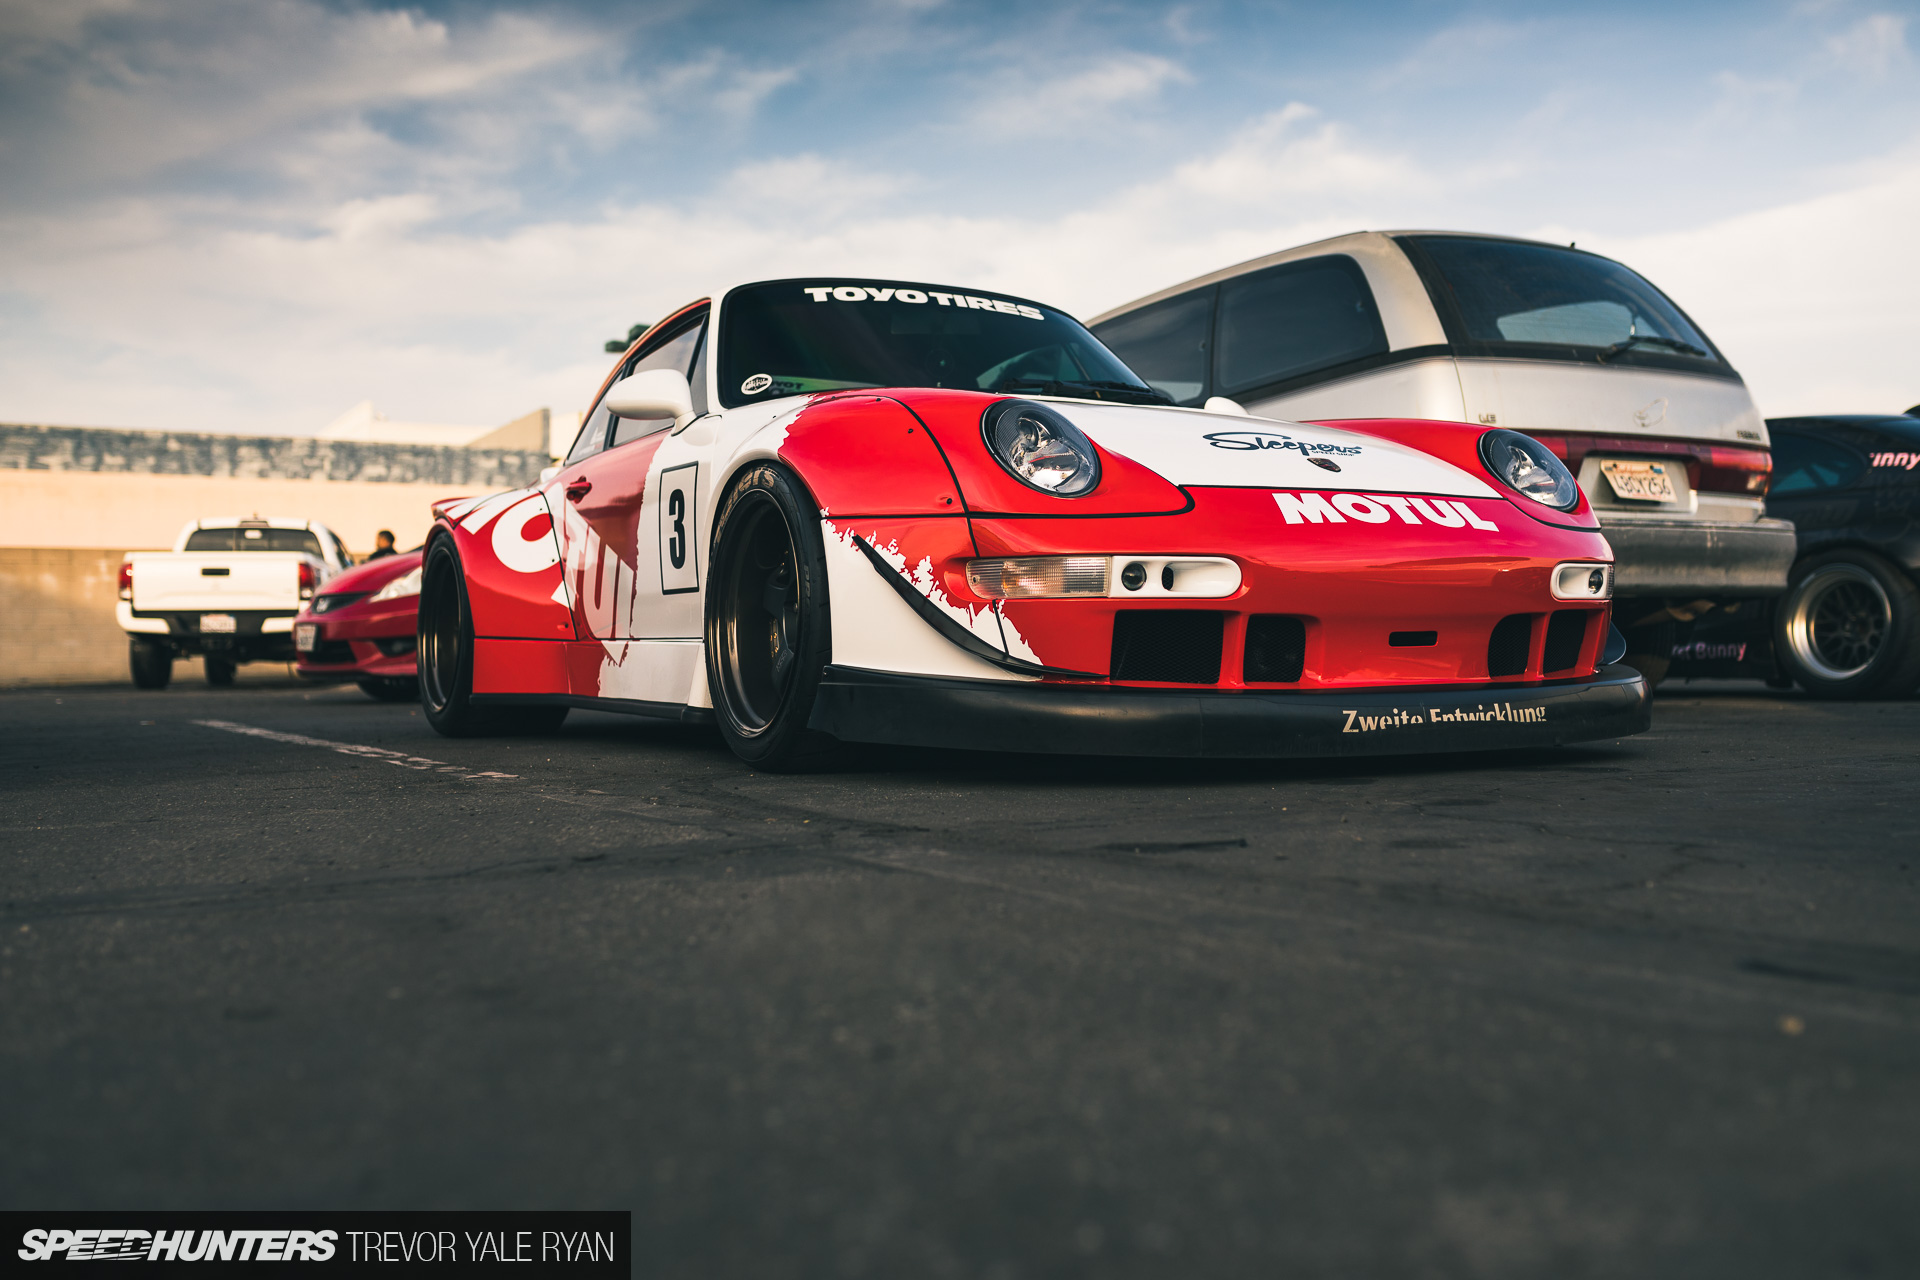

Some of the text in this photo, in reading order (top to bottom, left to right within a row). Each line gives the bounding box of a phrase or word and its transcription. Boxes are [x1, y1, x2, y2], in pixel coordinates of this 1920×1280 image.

[1202, 431, 1363, 457] Sleepers
[668, 488, 686, 570] 3
[1271, 492, 1500, 532] MOTUL
